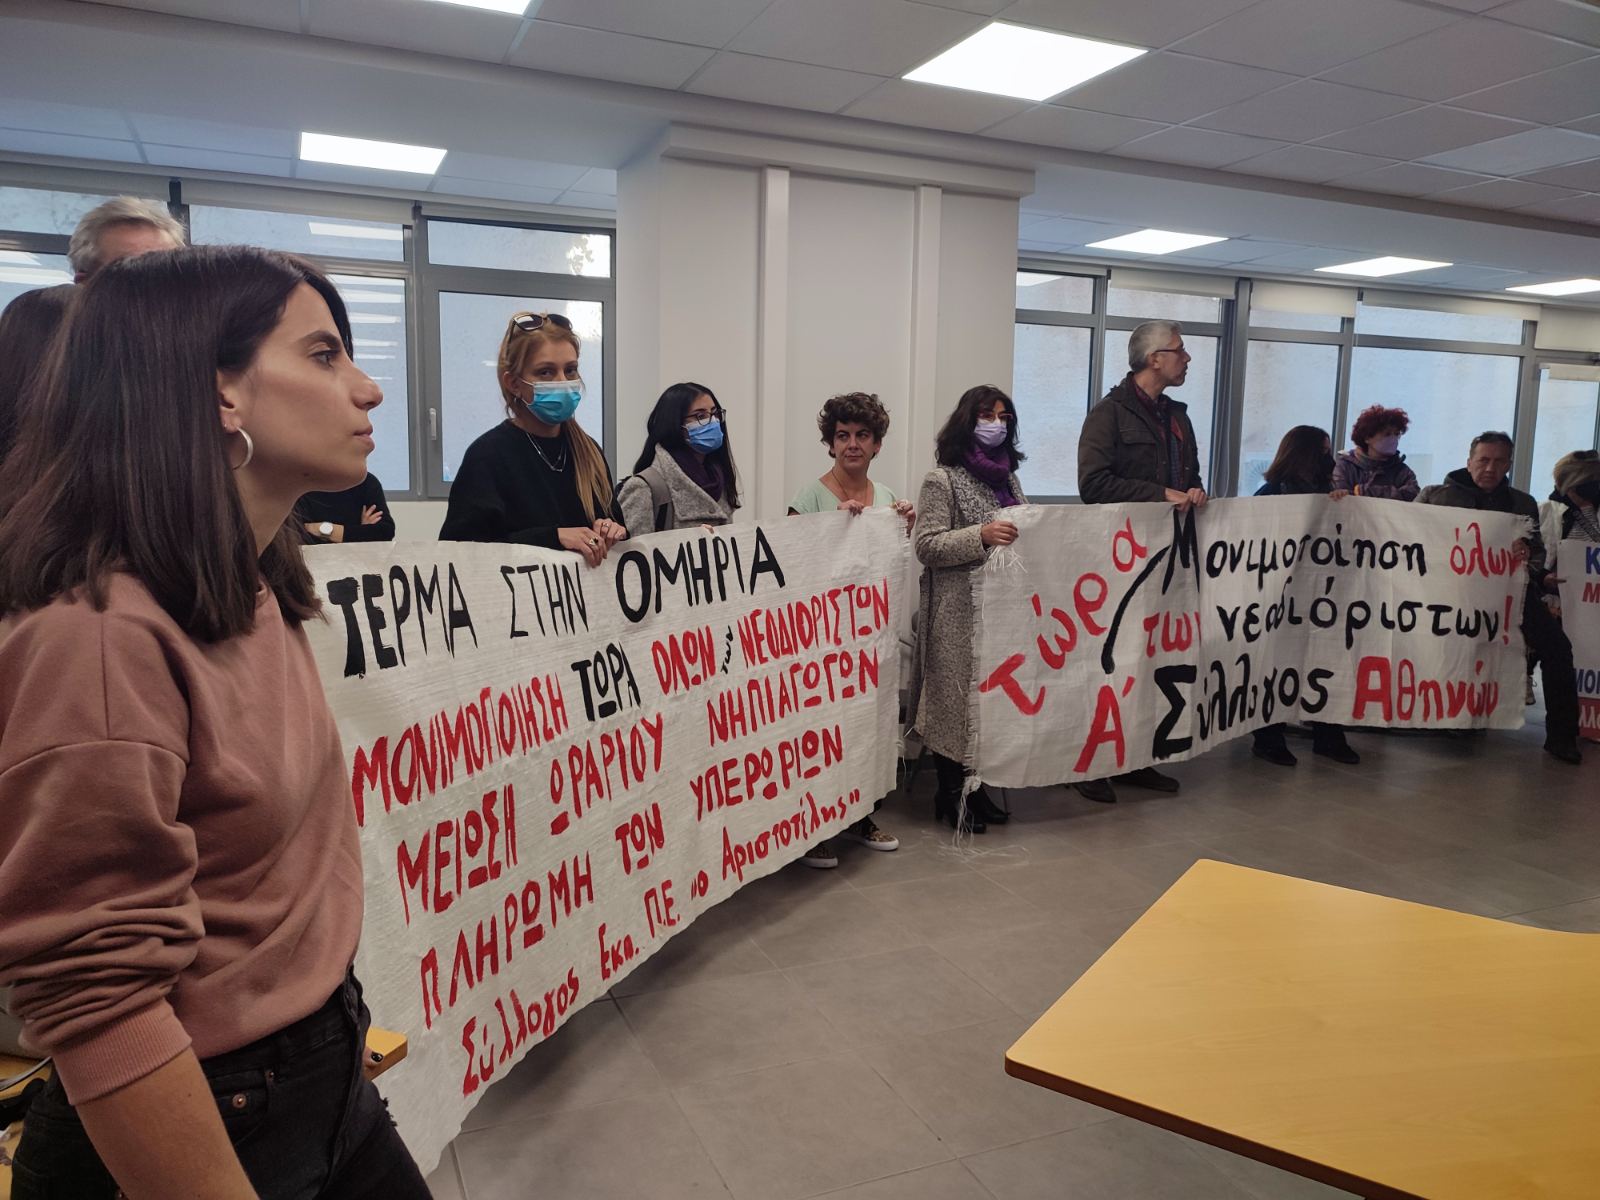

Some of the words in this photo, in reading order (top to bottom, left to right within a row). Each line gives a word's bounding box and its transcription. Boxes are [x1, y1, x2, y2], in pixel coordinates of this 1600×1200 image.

[326, 562, 478, 679] ΤΕΡΜΑ
[500, 562, 589, 639] ΣΤΗΝ
[615, 526, 786, 623] ΟΜΗΡΙΑ
[352, 672, 569, 828] ΜΟΝΙΜΟΠΟΙΗΣΗ
[571, 641, 641, 722] ΤΩΡΑ
[651, 625, 717, 696] ΟΛΩΝ
[737, 577, 890, 669] ΝΕΟΔΙΟΡΙΣΤΩΝ
[1352, 656, 1499, 722] Αθηνών
[397, 783, 518, 928] ΜΕΙΩΣΗ
[551, 712, 664, 836] ΩΡΑΡΙΟΥ
[706, 647, 879, 747] ΝΗΠΙΑΓΩΓΩΝ
[421, 850, 594, 1031] ΠΛΗΡΩΜΗ
[615, 803, 665, 875] ΤΩΝ
[690, 724, 843, 822] ΥΠΕΡΩΡΙΩΝ
[462, 966, 580, 1097] Σύλλογος
[644, 879, 681, 938] Π.Ε.
